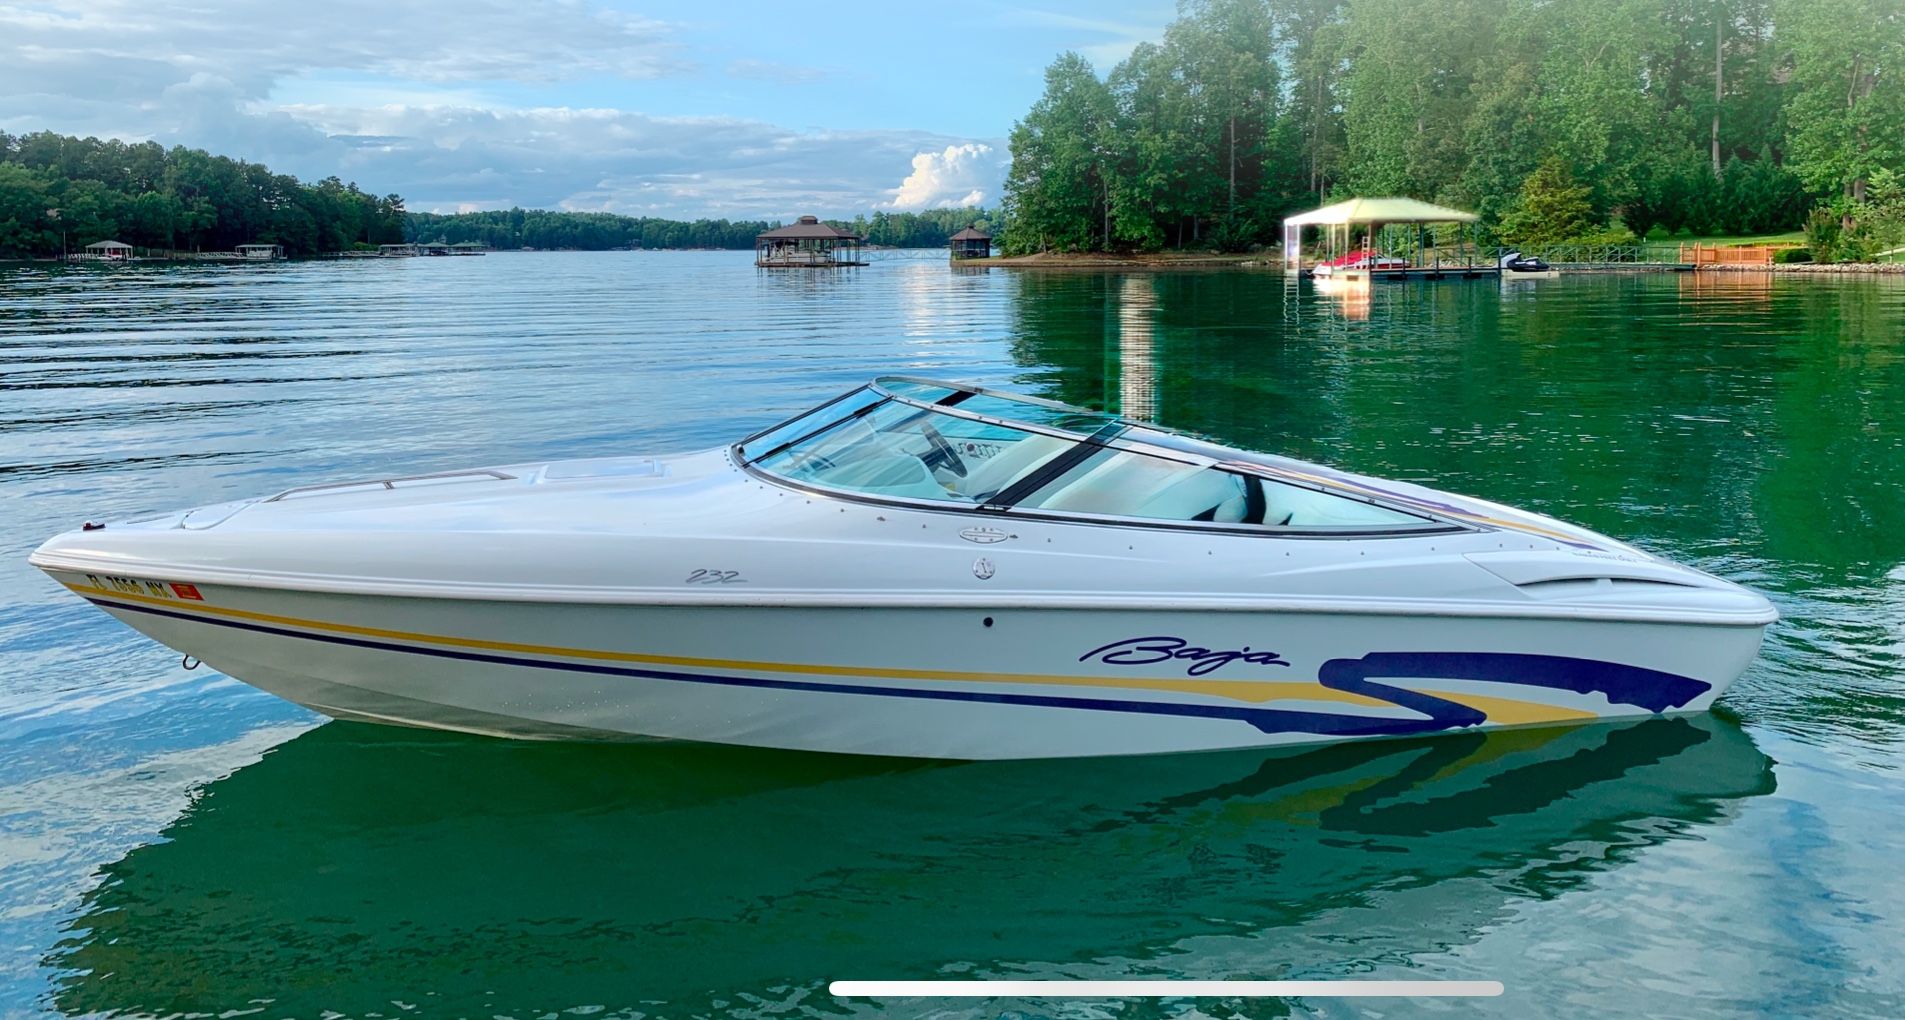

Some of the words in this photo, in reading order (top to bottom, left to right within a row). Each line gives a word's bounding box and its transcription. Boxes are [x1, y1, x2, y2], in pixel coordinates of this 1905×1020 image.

[86, 574, 107, 590] FL
[685, 568, 748, 584] 232
[1079, 636, 1291, 676] Baja
